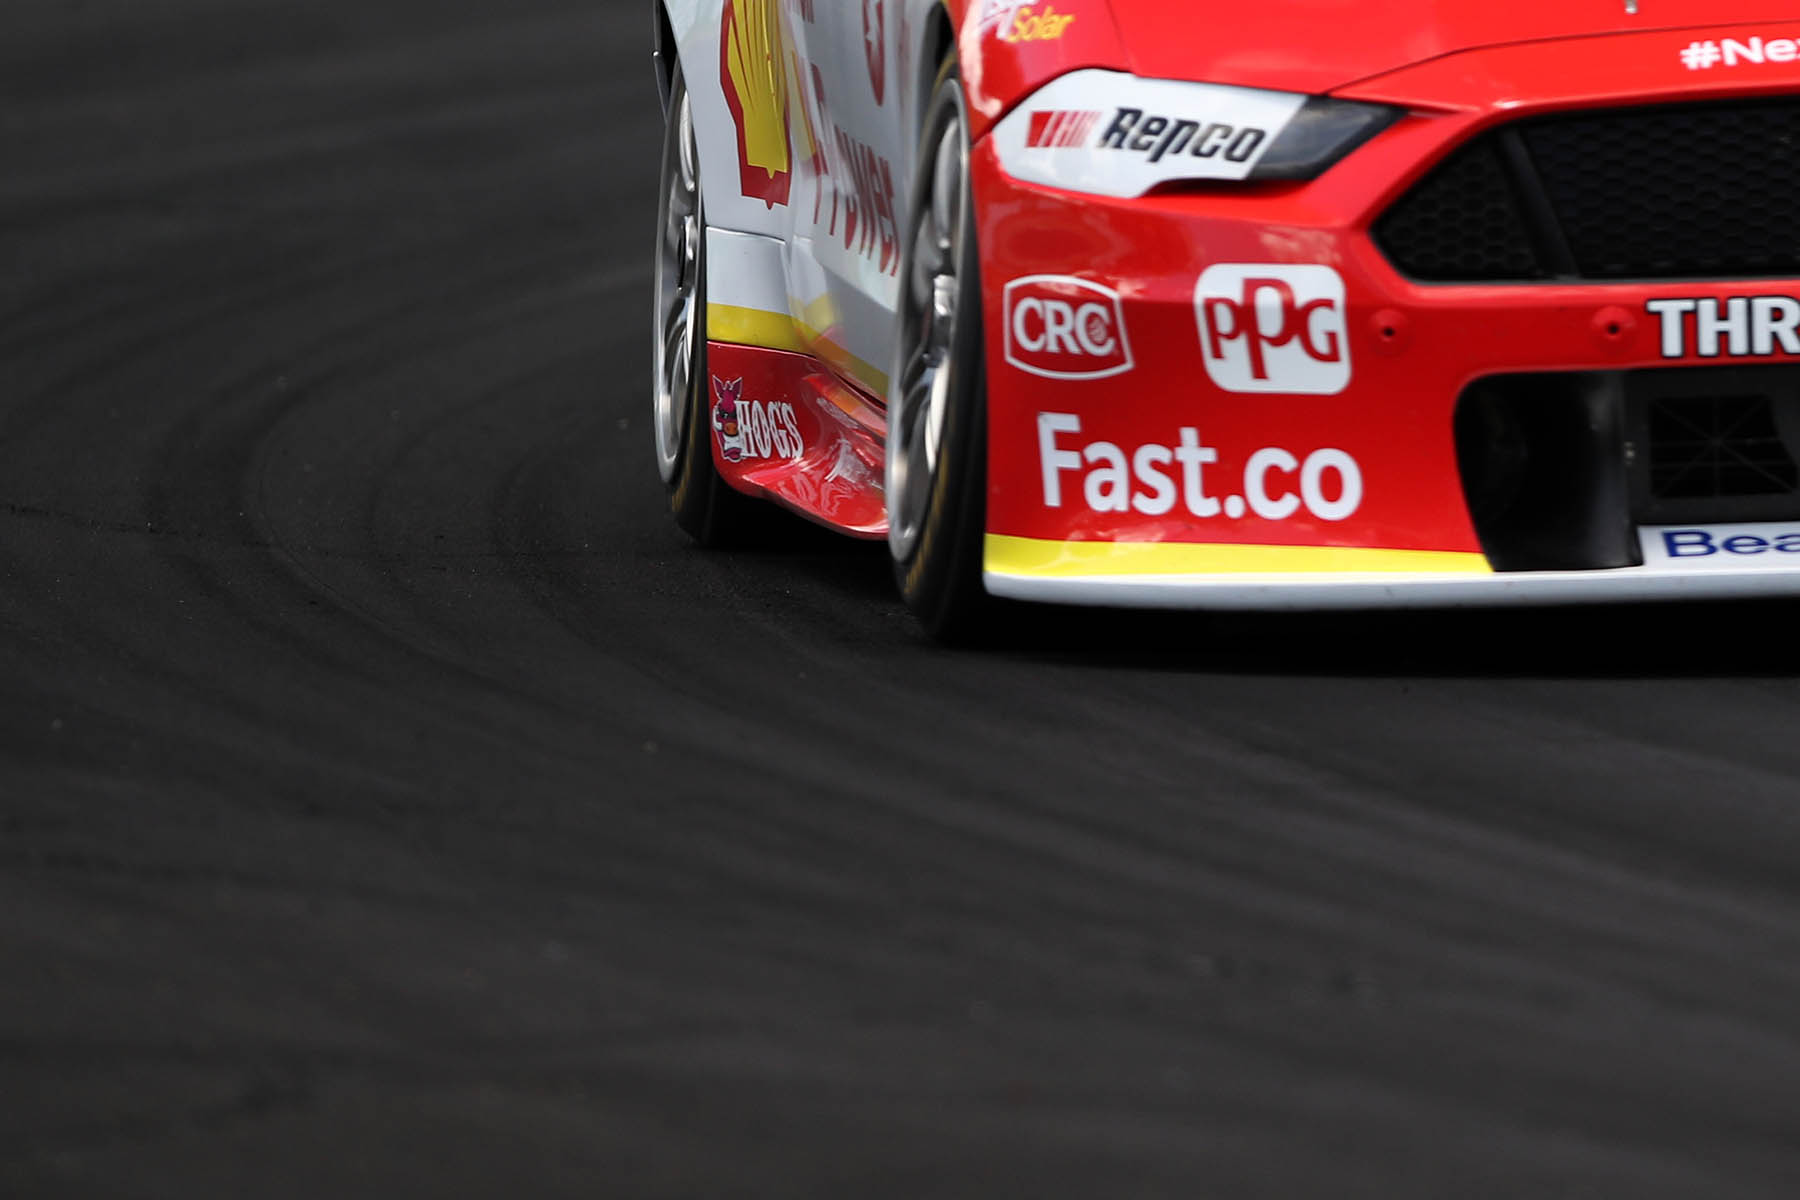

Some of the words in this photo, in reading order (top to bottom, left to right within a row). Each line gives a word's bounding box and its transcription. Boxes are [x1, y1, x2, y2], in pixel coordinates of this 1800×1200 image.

[1098, 107, 1266, 164] Repco
[1013, 296, 1116, 357] CRC
[1204, 277, 1341, 380] PPG
[737, 399, 804, 460] HOGS
[1037, 411, 1364, 521] Fast.co
